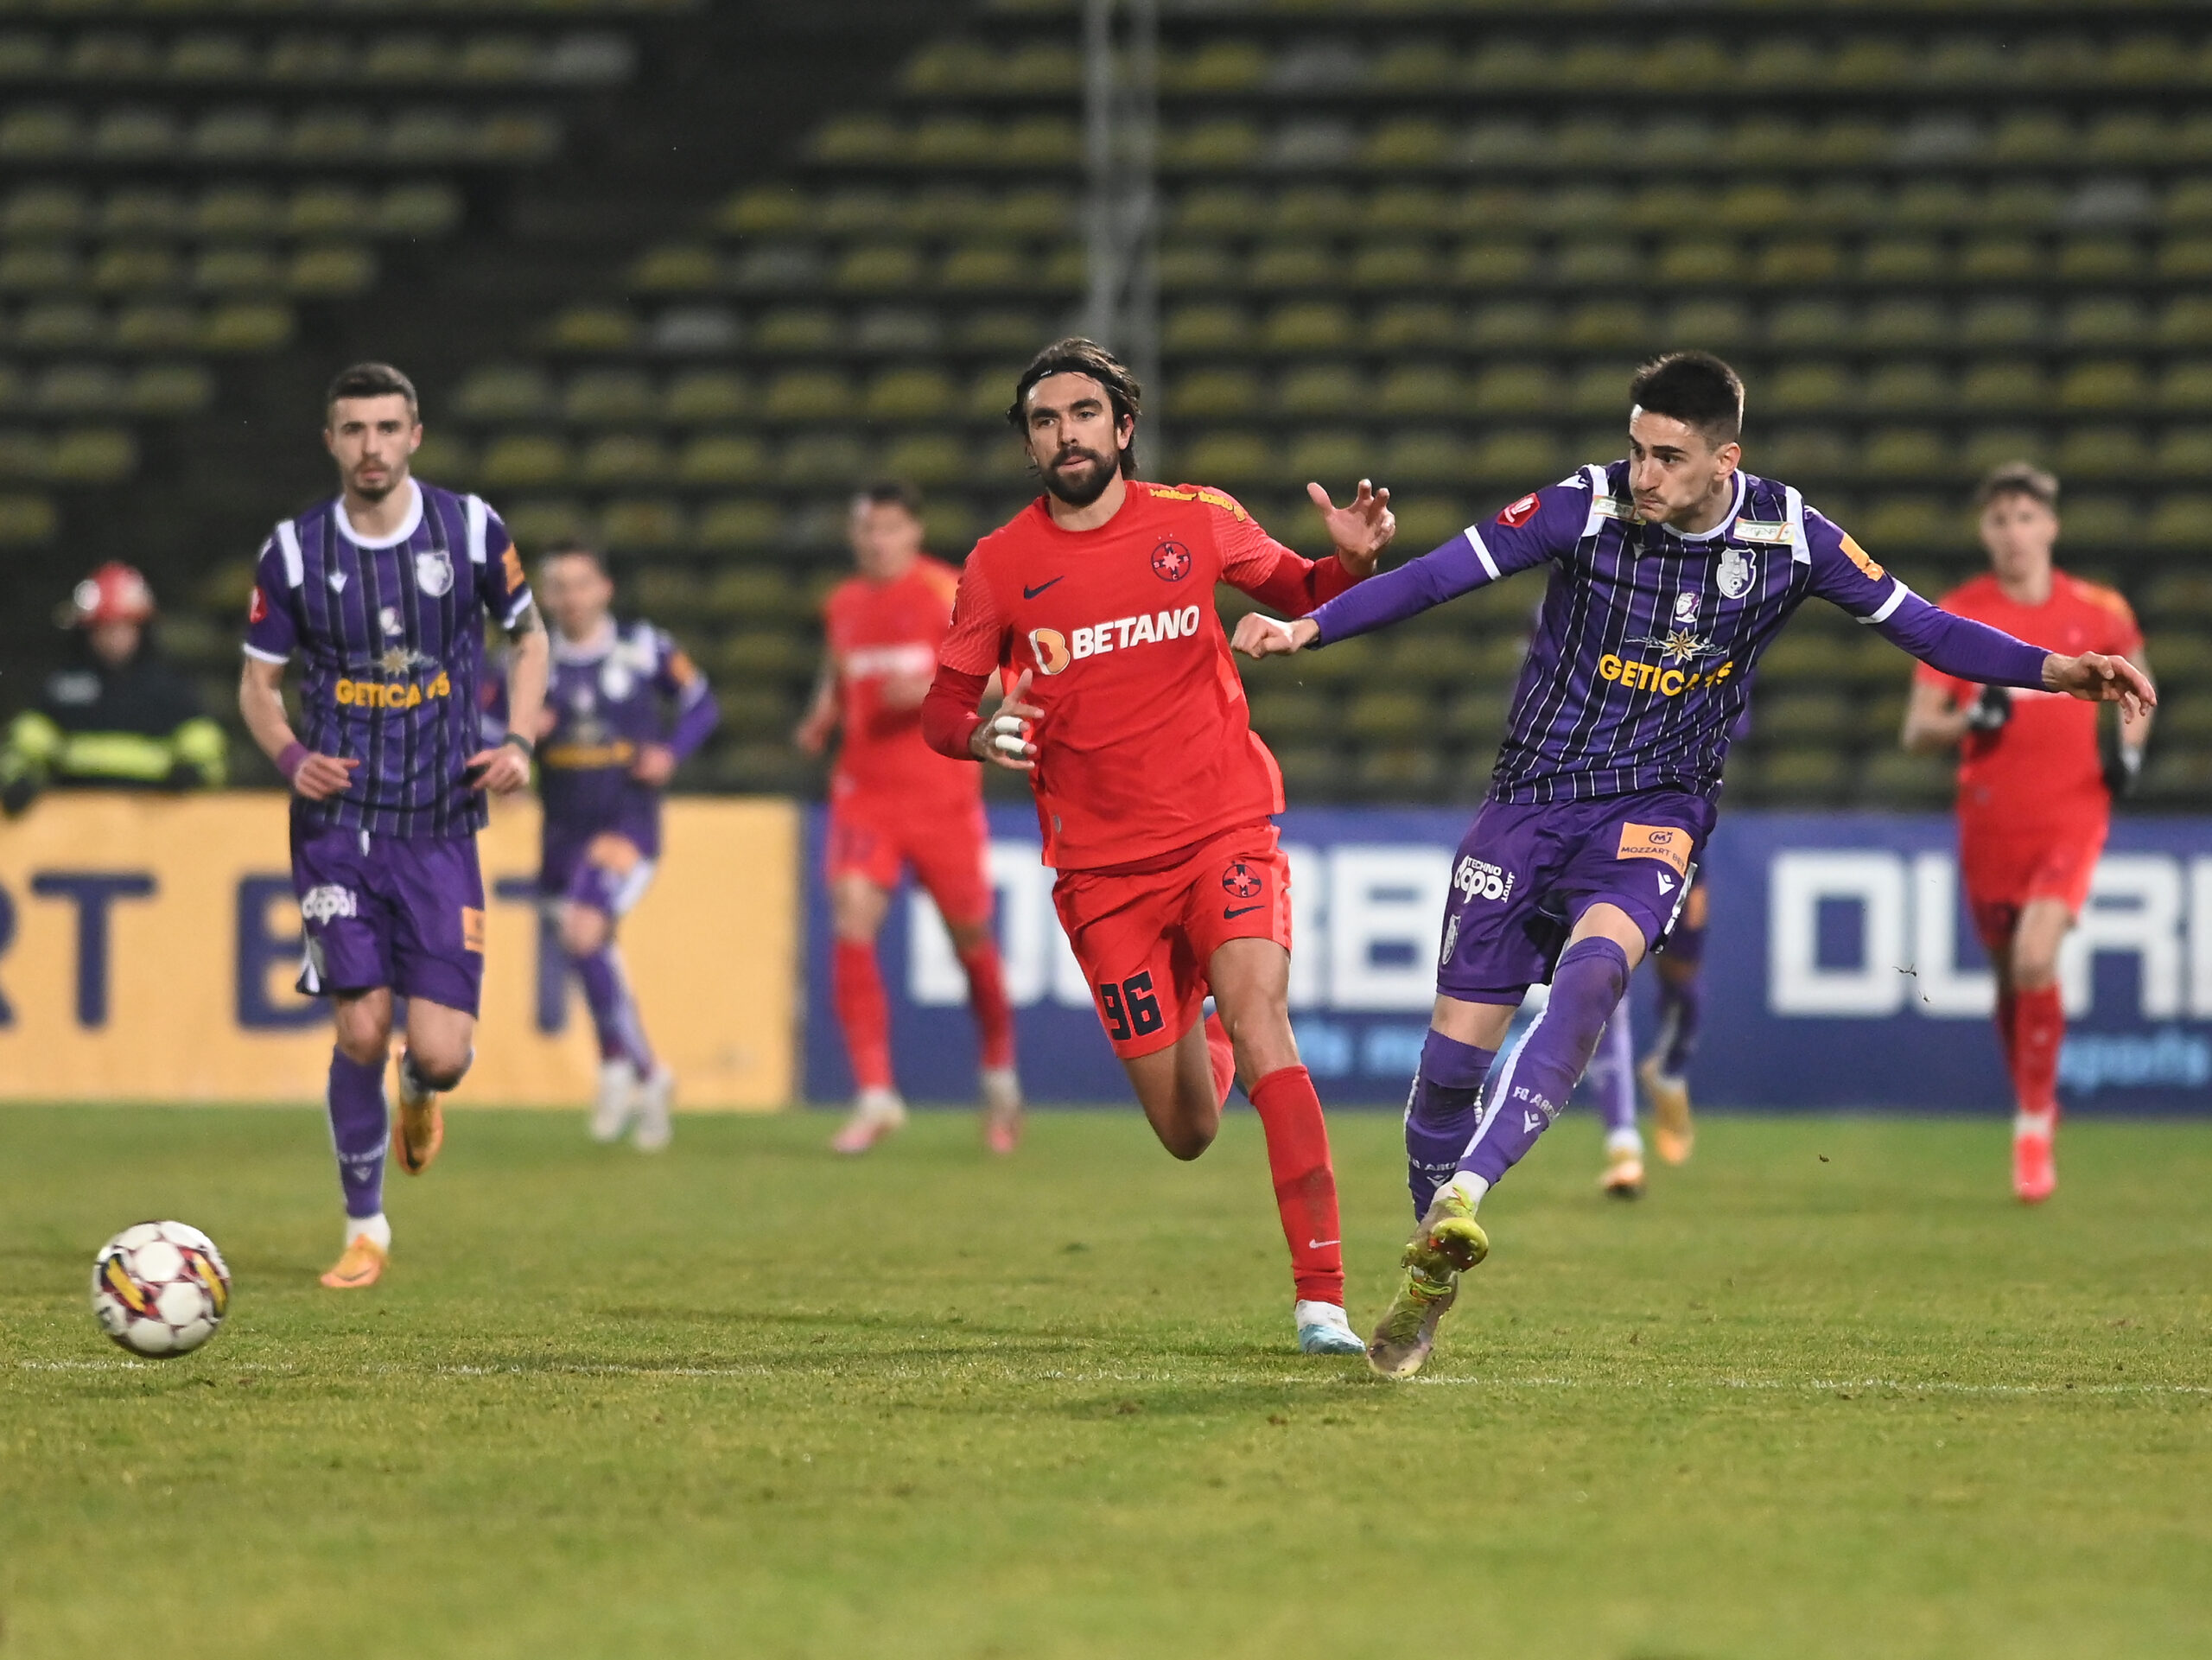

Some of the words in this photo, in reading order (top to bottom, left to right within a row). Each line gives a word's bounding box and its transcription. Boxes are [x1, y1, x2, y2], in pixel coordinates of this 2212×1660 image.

[1071, 605, 1200, 660] BETANO
[1467, 856, 1503, 877] TECHNO
[1620, 846, 1671, 857] MOZZART
[0, 870, 158, 1031] T
[1099, 969, 1166, 1041] 96
